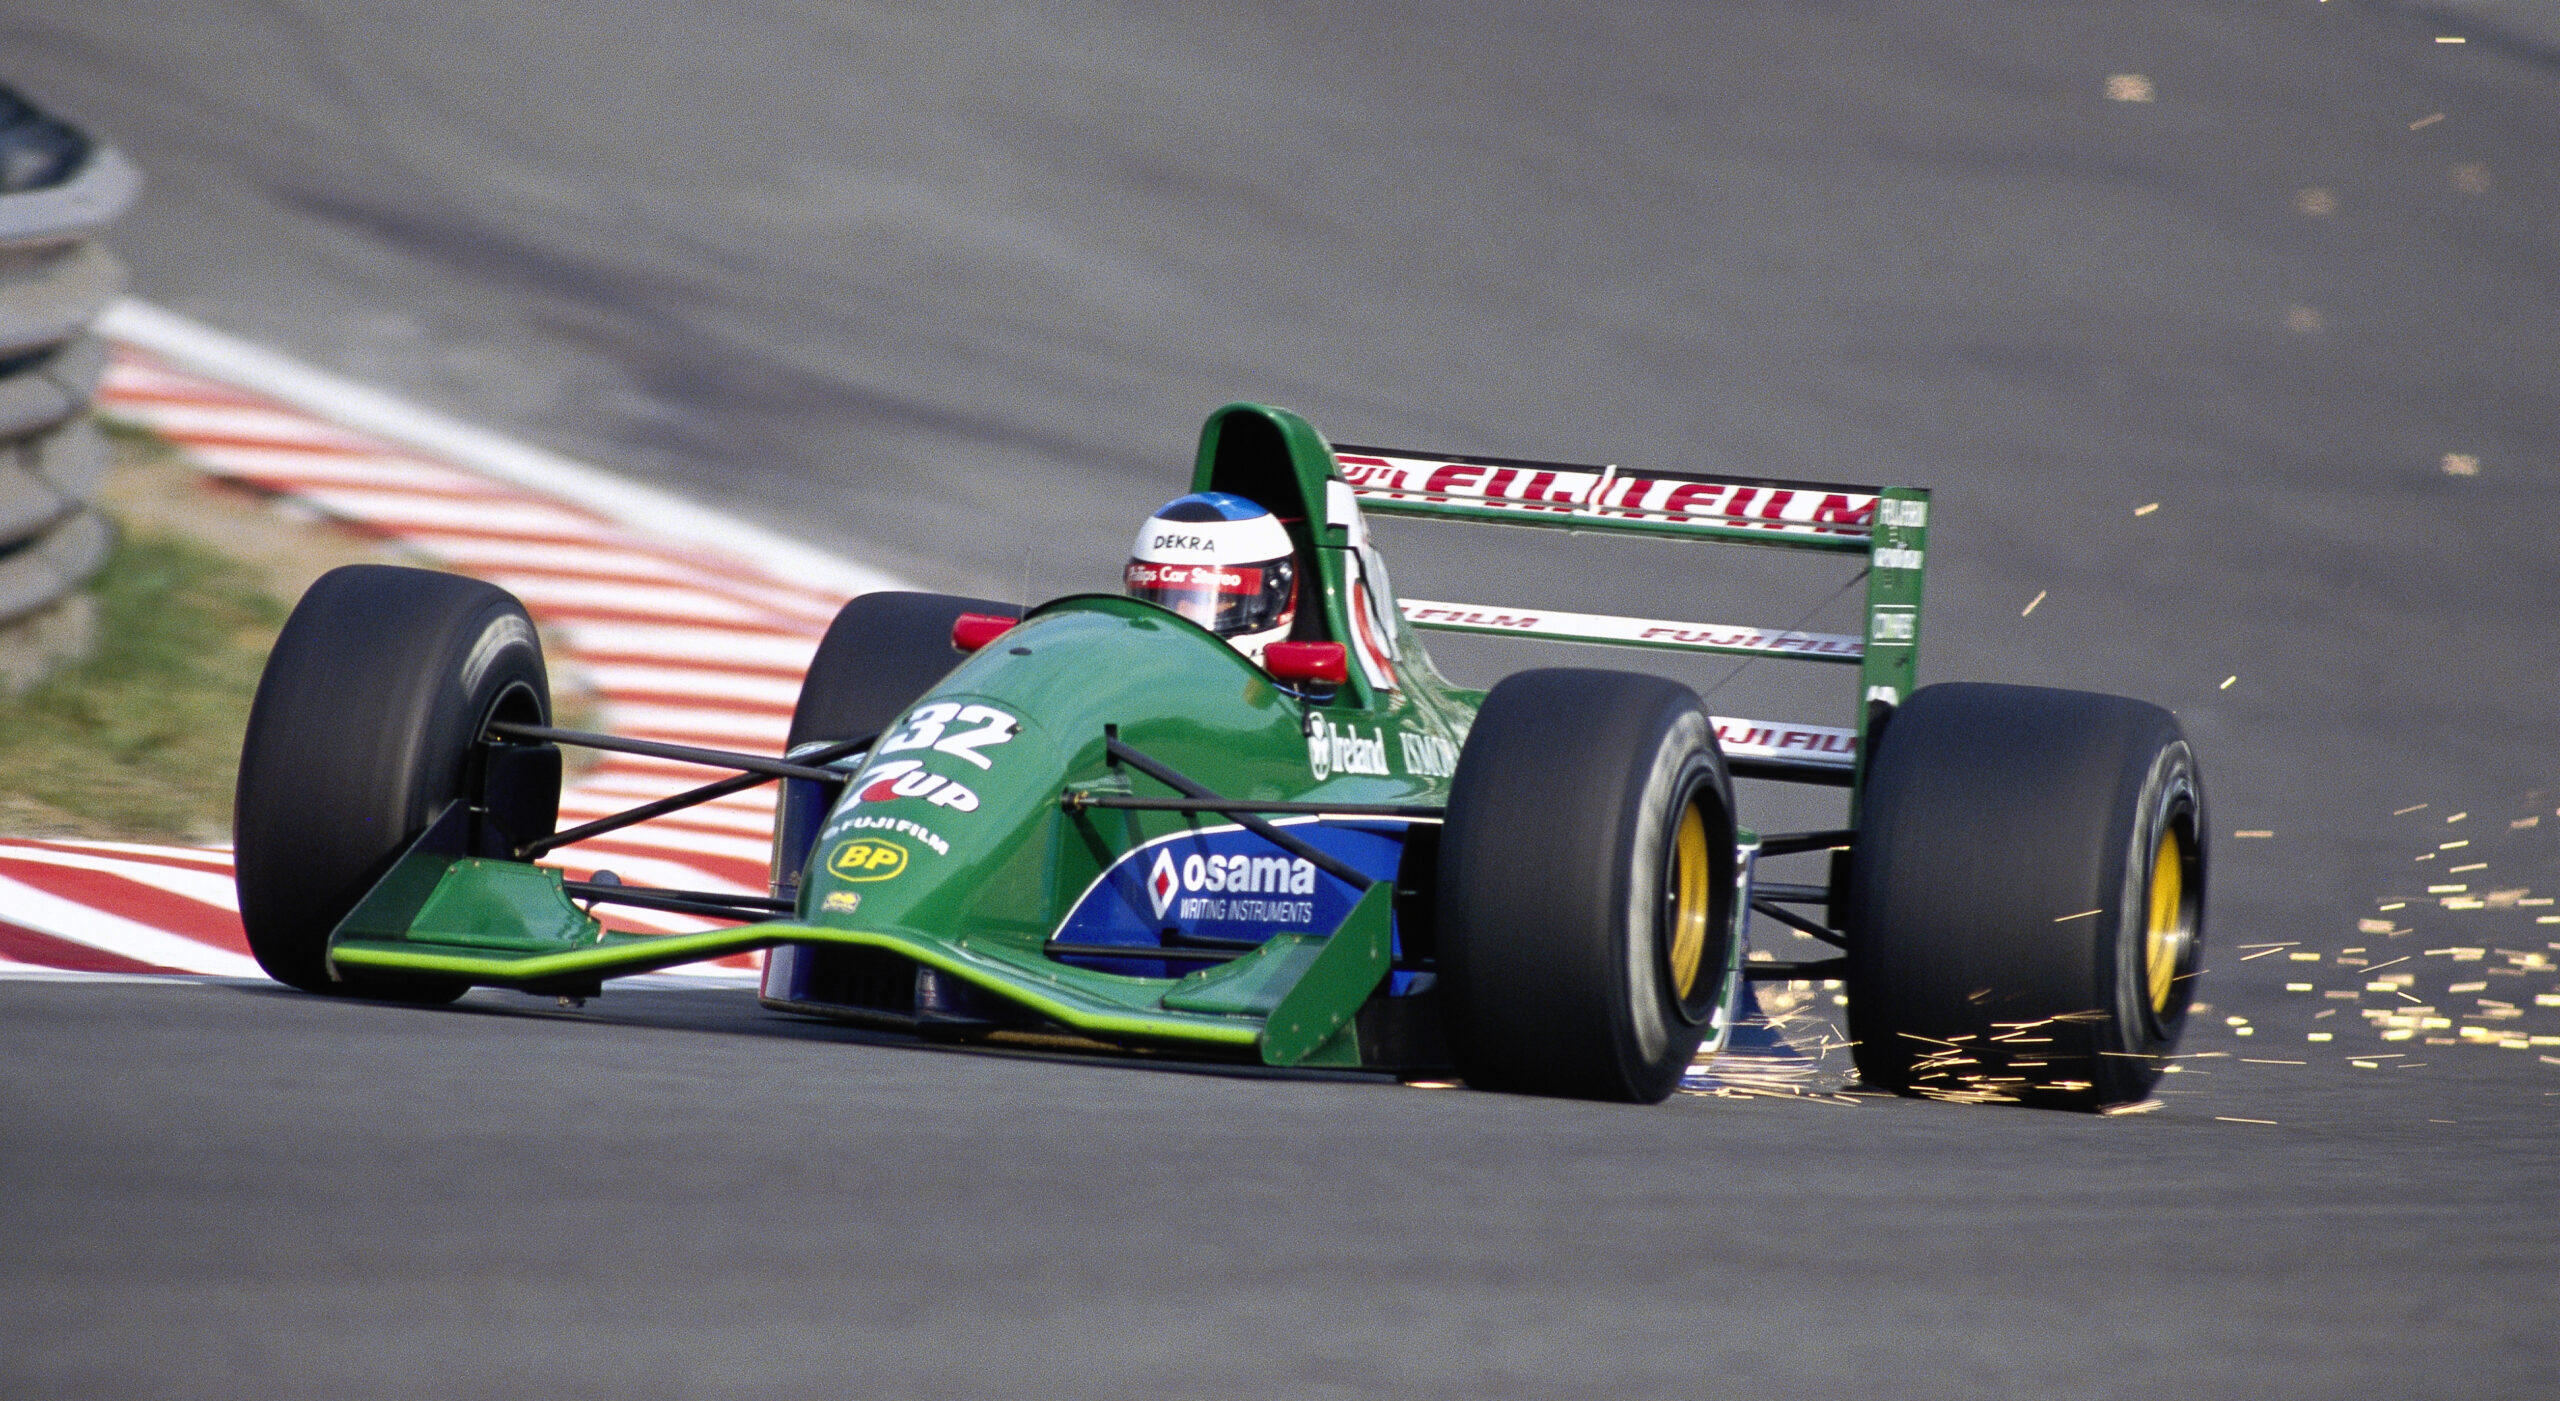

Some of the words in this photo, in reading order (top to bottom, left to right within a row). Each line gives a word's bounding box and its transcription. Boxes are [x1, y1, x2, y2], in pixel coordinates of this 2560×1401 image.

[1154, 534, 1215, 552] DEKRA
[1160, 566, 1189, 582] Car
[879, 702, 1018, 770] 32
[1328, 722, 1390, 776] Ireland
[837, 845, 899, 871] BP
[1183, 853, 1316, 895] osama
[1180, 898, 1227, 922] WRITING
[1228, 899, 1314, 923] INSTRUMENTS
